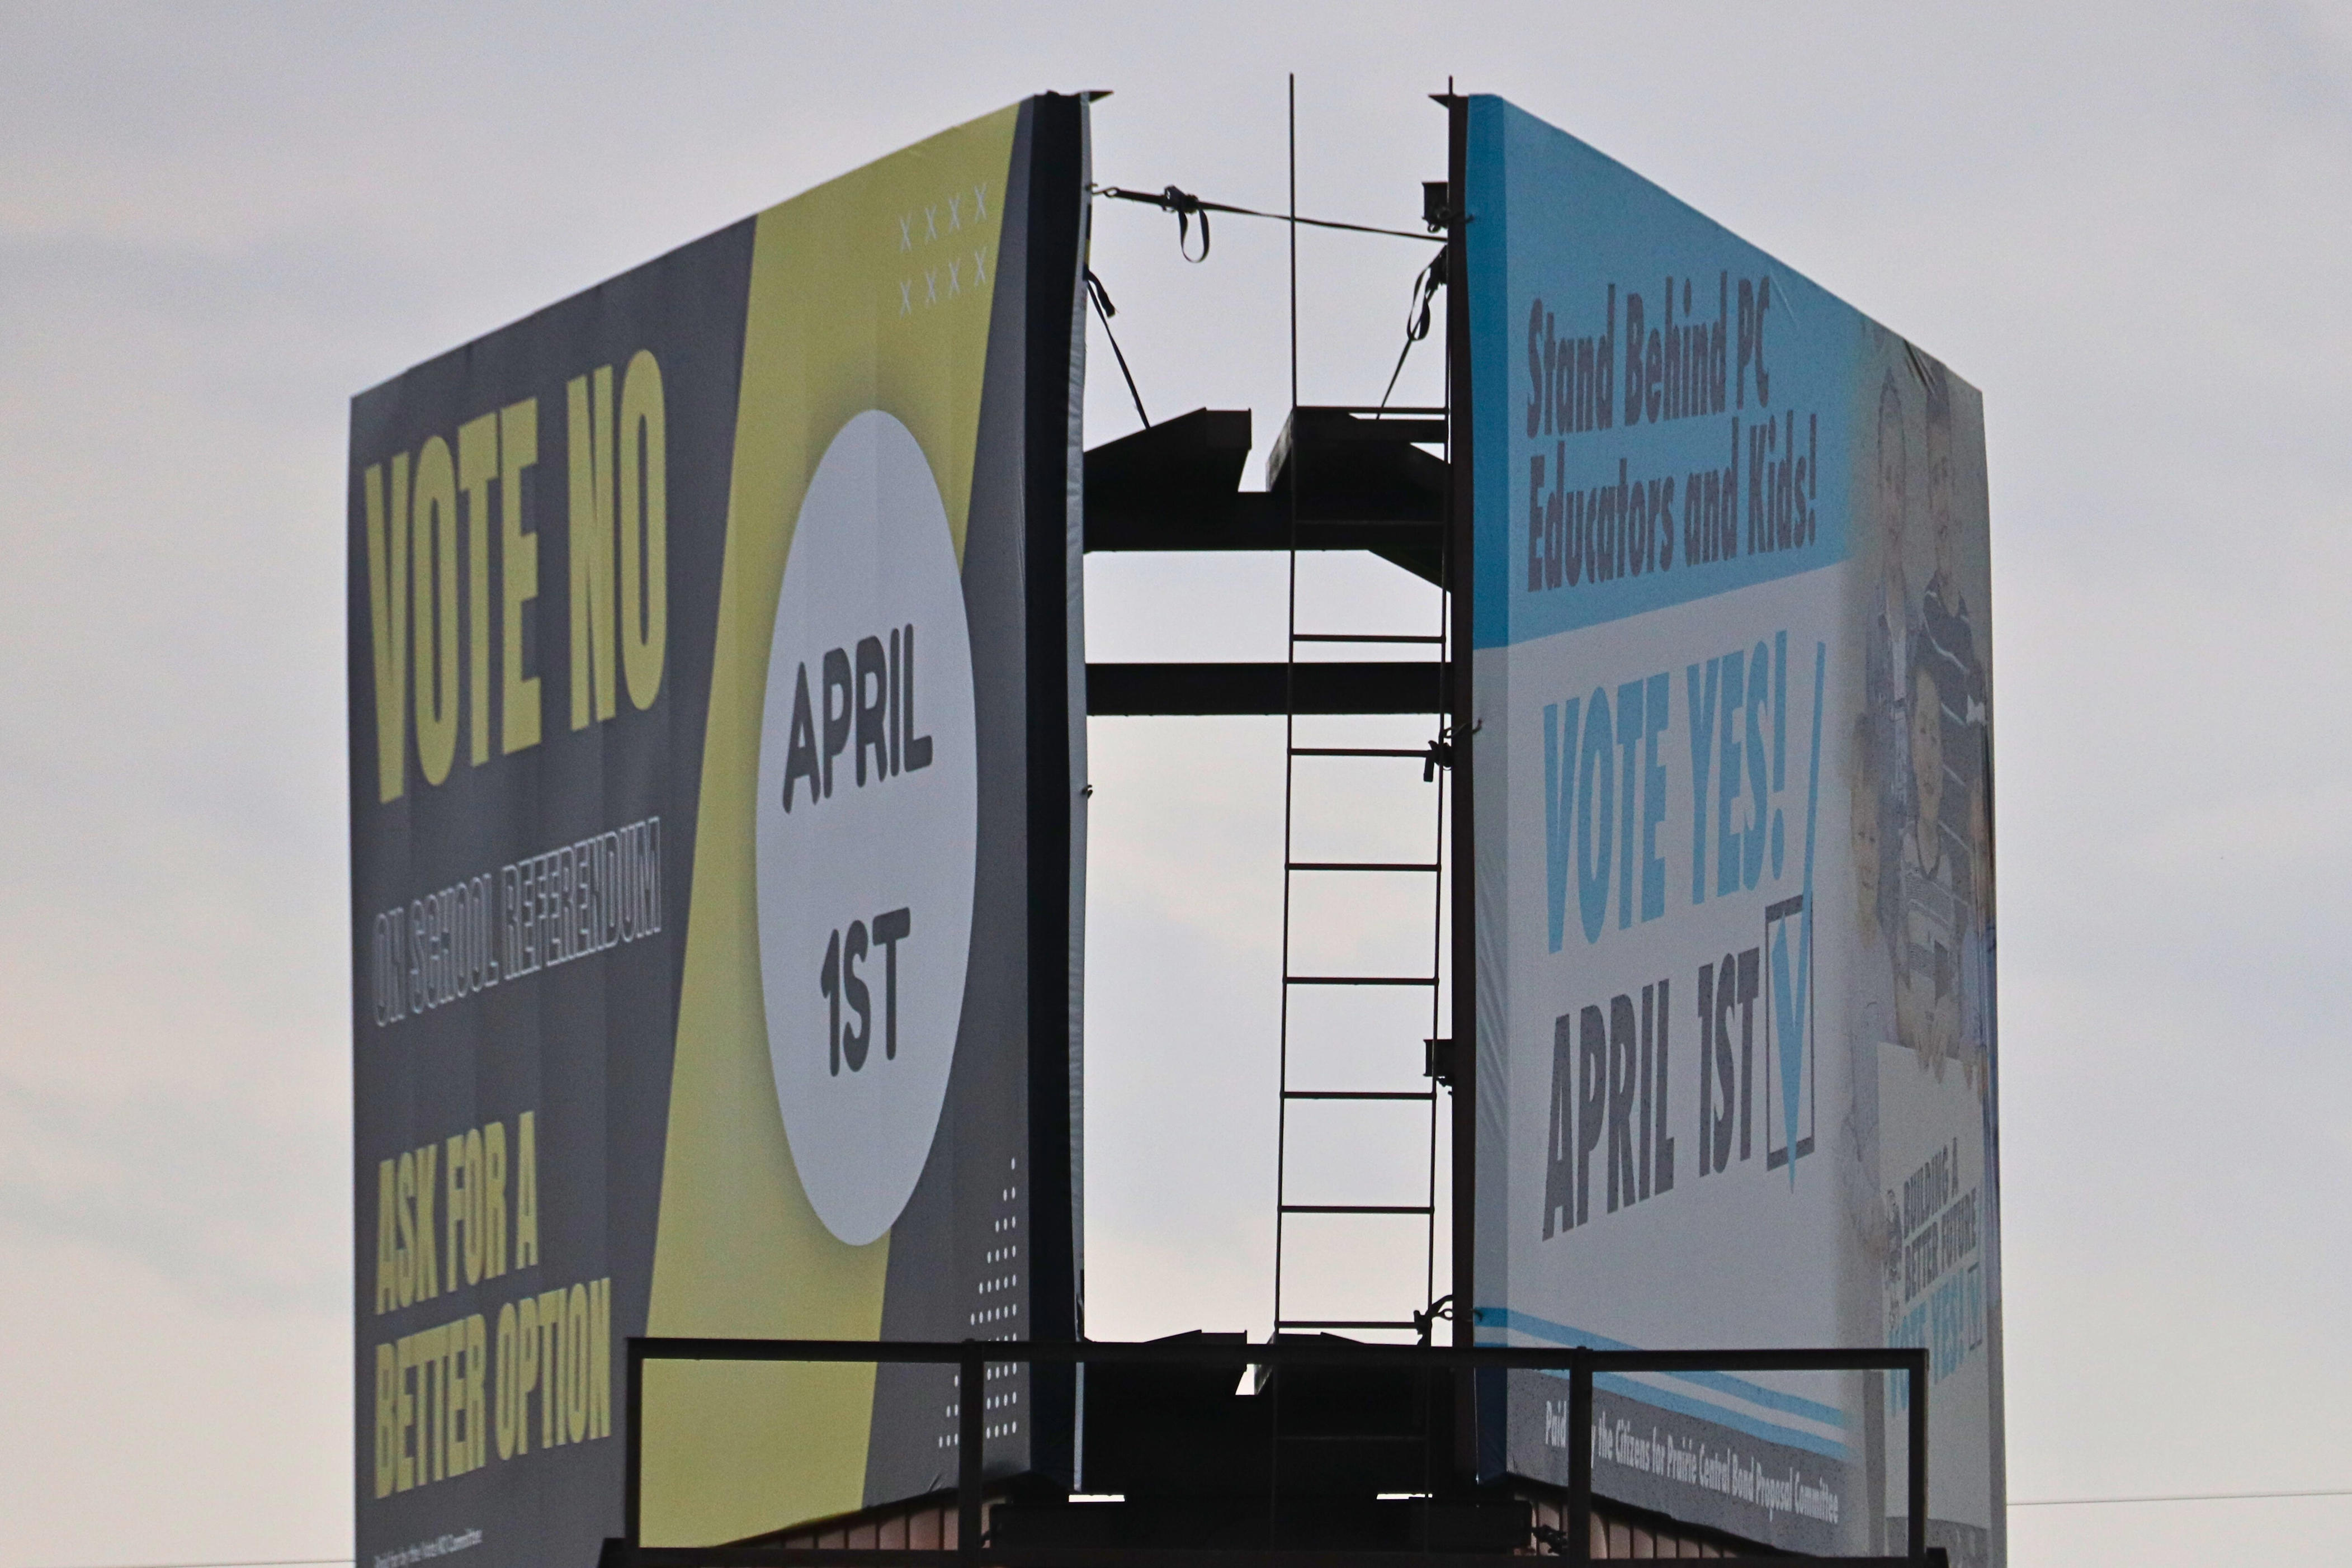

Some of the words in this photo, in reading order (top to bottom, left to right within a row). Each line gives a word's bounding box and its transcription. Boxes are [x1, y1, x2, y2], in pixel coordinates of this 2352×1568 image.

[1527, 283, 1616, 439] Stand
[1624, 270, 1727, 427] Behind
[1736, 275, 1770, 410] PC
[365, 397, 541, 804] VOTE
[566, 348, 667, 731] NO
[1528, 440, 1674, 593] Educators
[1684, 416, 1739, 568] and
[1748, 409, 1817, 555] Kids!
[783, 623, 933, 814] APRIL
[1543, 672, 1670, 955] VOTE
[1686, 629, 1787, 905] YES!
[410, 872, 499, 1014] SCHOOL
[503, 816, 661, 980] REFERENDUM
[821, 906, 911, 1078] 1ST
[1542, 978, 1674, 1242] APRIL
[1698, 946, 1760, 1178] 1ST
[375, 1144, 439, 1315] ASK
[447, 1121, 507, 1293] FOR
[515, 1111, 539, 1270] A
[375, 1313, 487, 1499] BETTER
[495, 1277, 611, 1461] OPTION
[1545, 1400, 1567, 1448] Paid
[1598, 1410, 1613, 1461] the
[1616, 1418, 1650, 1472] Citizens
[1652, 1426, 1665, 1476] for
[1667, 1434, 1697, 1484] Prairie
[1699, 1443, 1731, 1494] Central
[1733, 1454, 1754, 1503] Bond
[1756, 1462, 1793, 1522] Proposal
[1794, 1471, 1839, 1524] Committee
